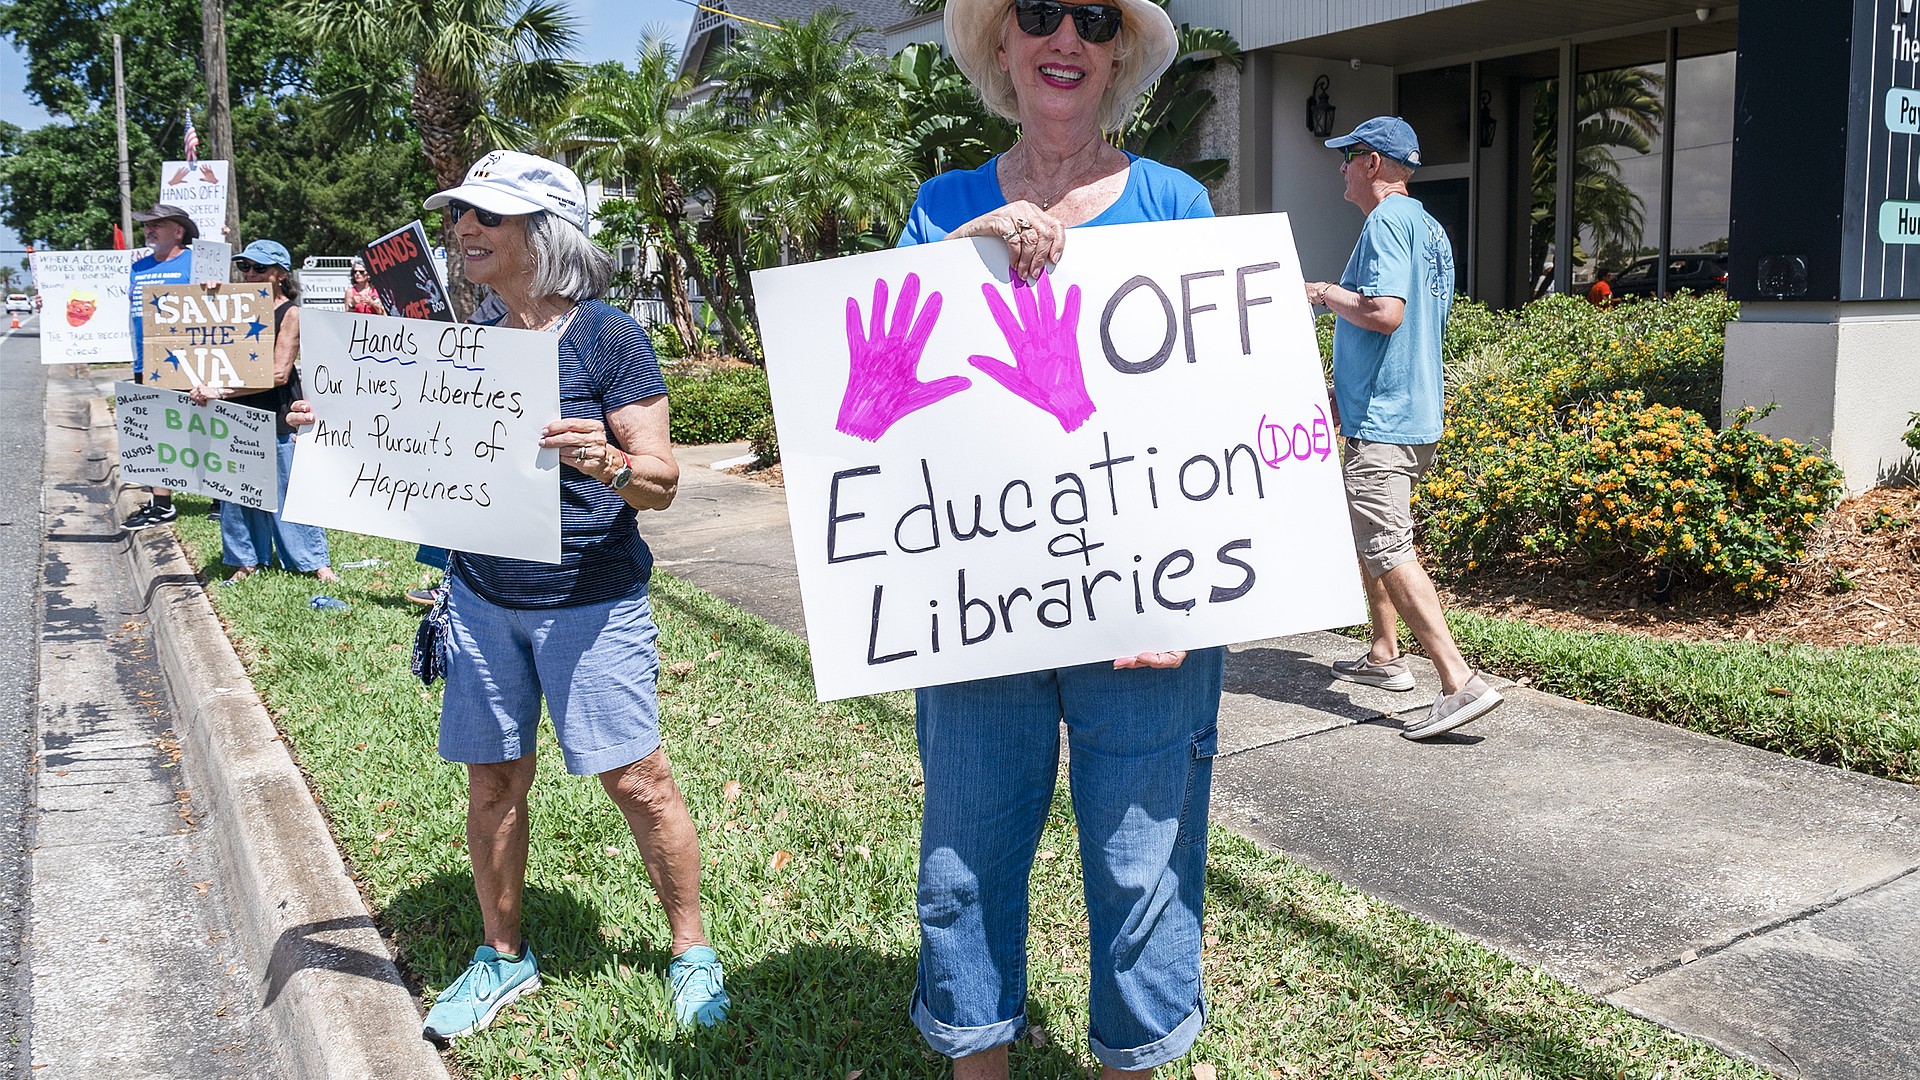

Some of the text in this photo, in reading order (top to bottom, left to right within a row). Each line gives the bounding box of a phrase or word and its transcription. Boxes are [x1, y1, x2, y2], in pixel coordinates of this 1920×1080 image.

[1900, 96, 1920, 132] Pa
[162, 185, 225, 201] HANDS OFF!
[189, 204, 220, 215] SPEECH
[1898, 208, 1920, 235] Hu
[40, 255, 69, 264] WHEN
[72, 255, 80, 264] A
[83, 254, 124, 265] CLOWN
[365, 231, 418, 275] HANDS
[44, 264, 75, 272] MOVES
[305, 284, 350, 293] MITCHEL
[154, 291, 258, 326] SAVE
[405, 298, 431, 319] OFF
[431, 301, 446, 313] DOD
[1100, 261, 1281, 375] OFF
[185, 325, 236, 346] THE
[349, 320, 487, 363] Hands Off
[172, 348, 245, 389] VA
[116, 393, 160, 406] Medicare
[314, 365, 525, 419] Our Lives, Liberties,
[132, 405, 149, 416] DE
[214, 404, 260, 433] Medicaid
[123, 426, 149, 442] Parks
[165, 408, 229, 440] BAD
[233, 435, 260, 448] Social
[314, 414, 507, 463] And Pursuits of
[121, 443, 155, 460] USDA
[229, 443, 266, 460] Security
[161, 477, 188, 488] DOD
[349, 462, 492, 511] Happiness
[827, 403, 1332, 565] Education (DOE)
[867, 538, 1257, 666] Libraries
